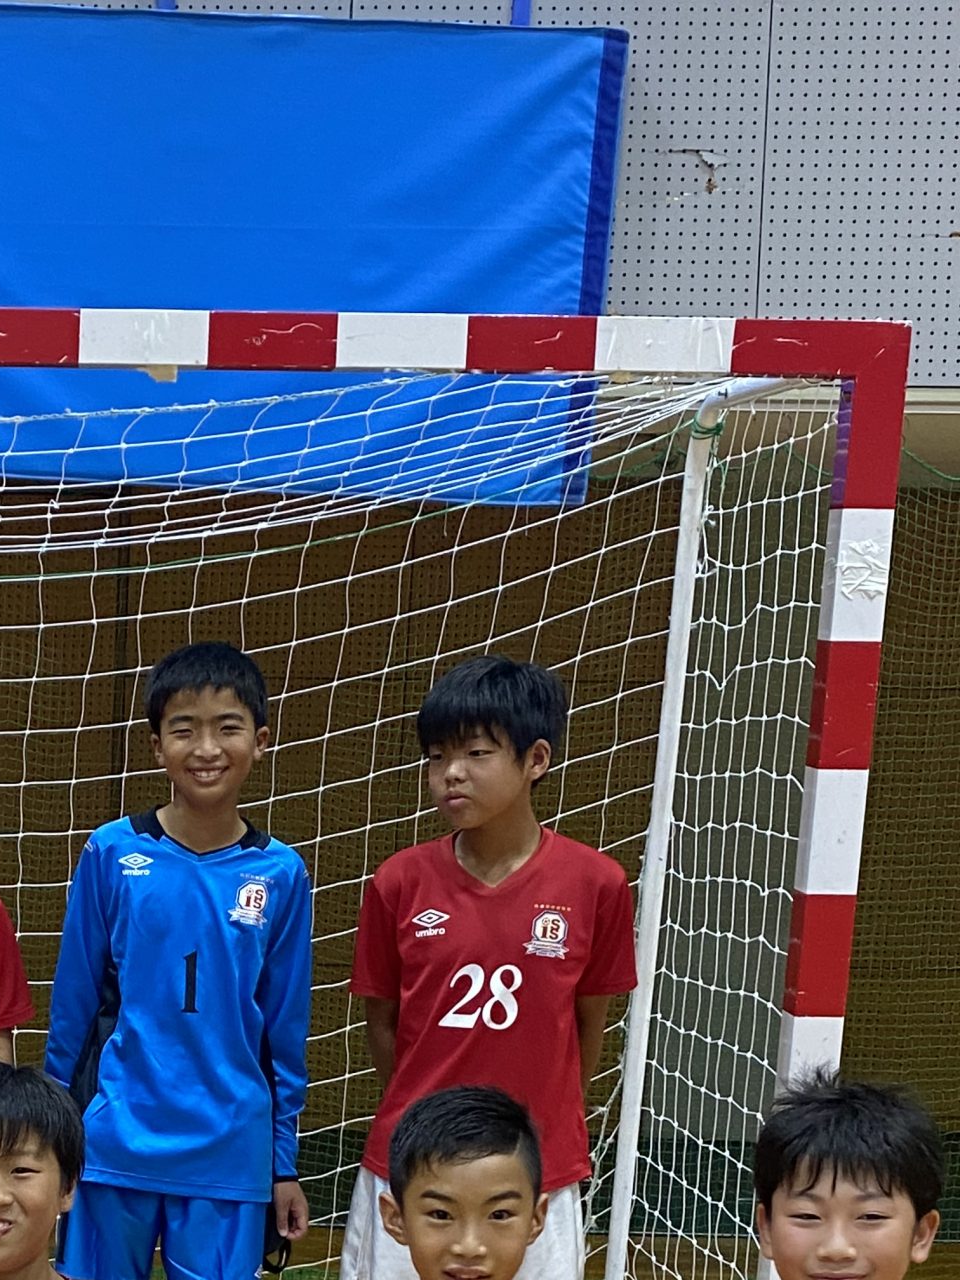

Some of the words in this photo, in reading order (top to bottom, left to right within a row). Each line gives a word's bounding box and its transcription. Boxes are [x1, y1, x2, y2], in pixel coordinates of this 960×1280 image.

[122, 867, 151, 876] umbro
[415, 927, 446, 938] umbro
[181, 950, 199, 1014] 1
[438, 963, 522, 1030] 28
